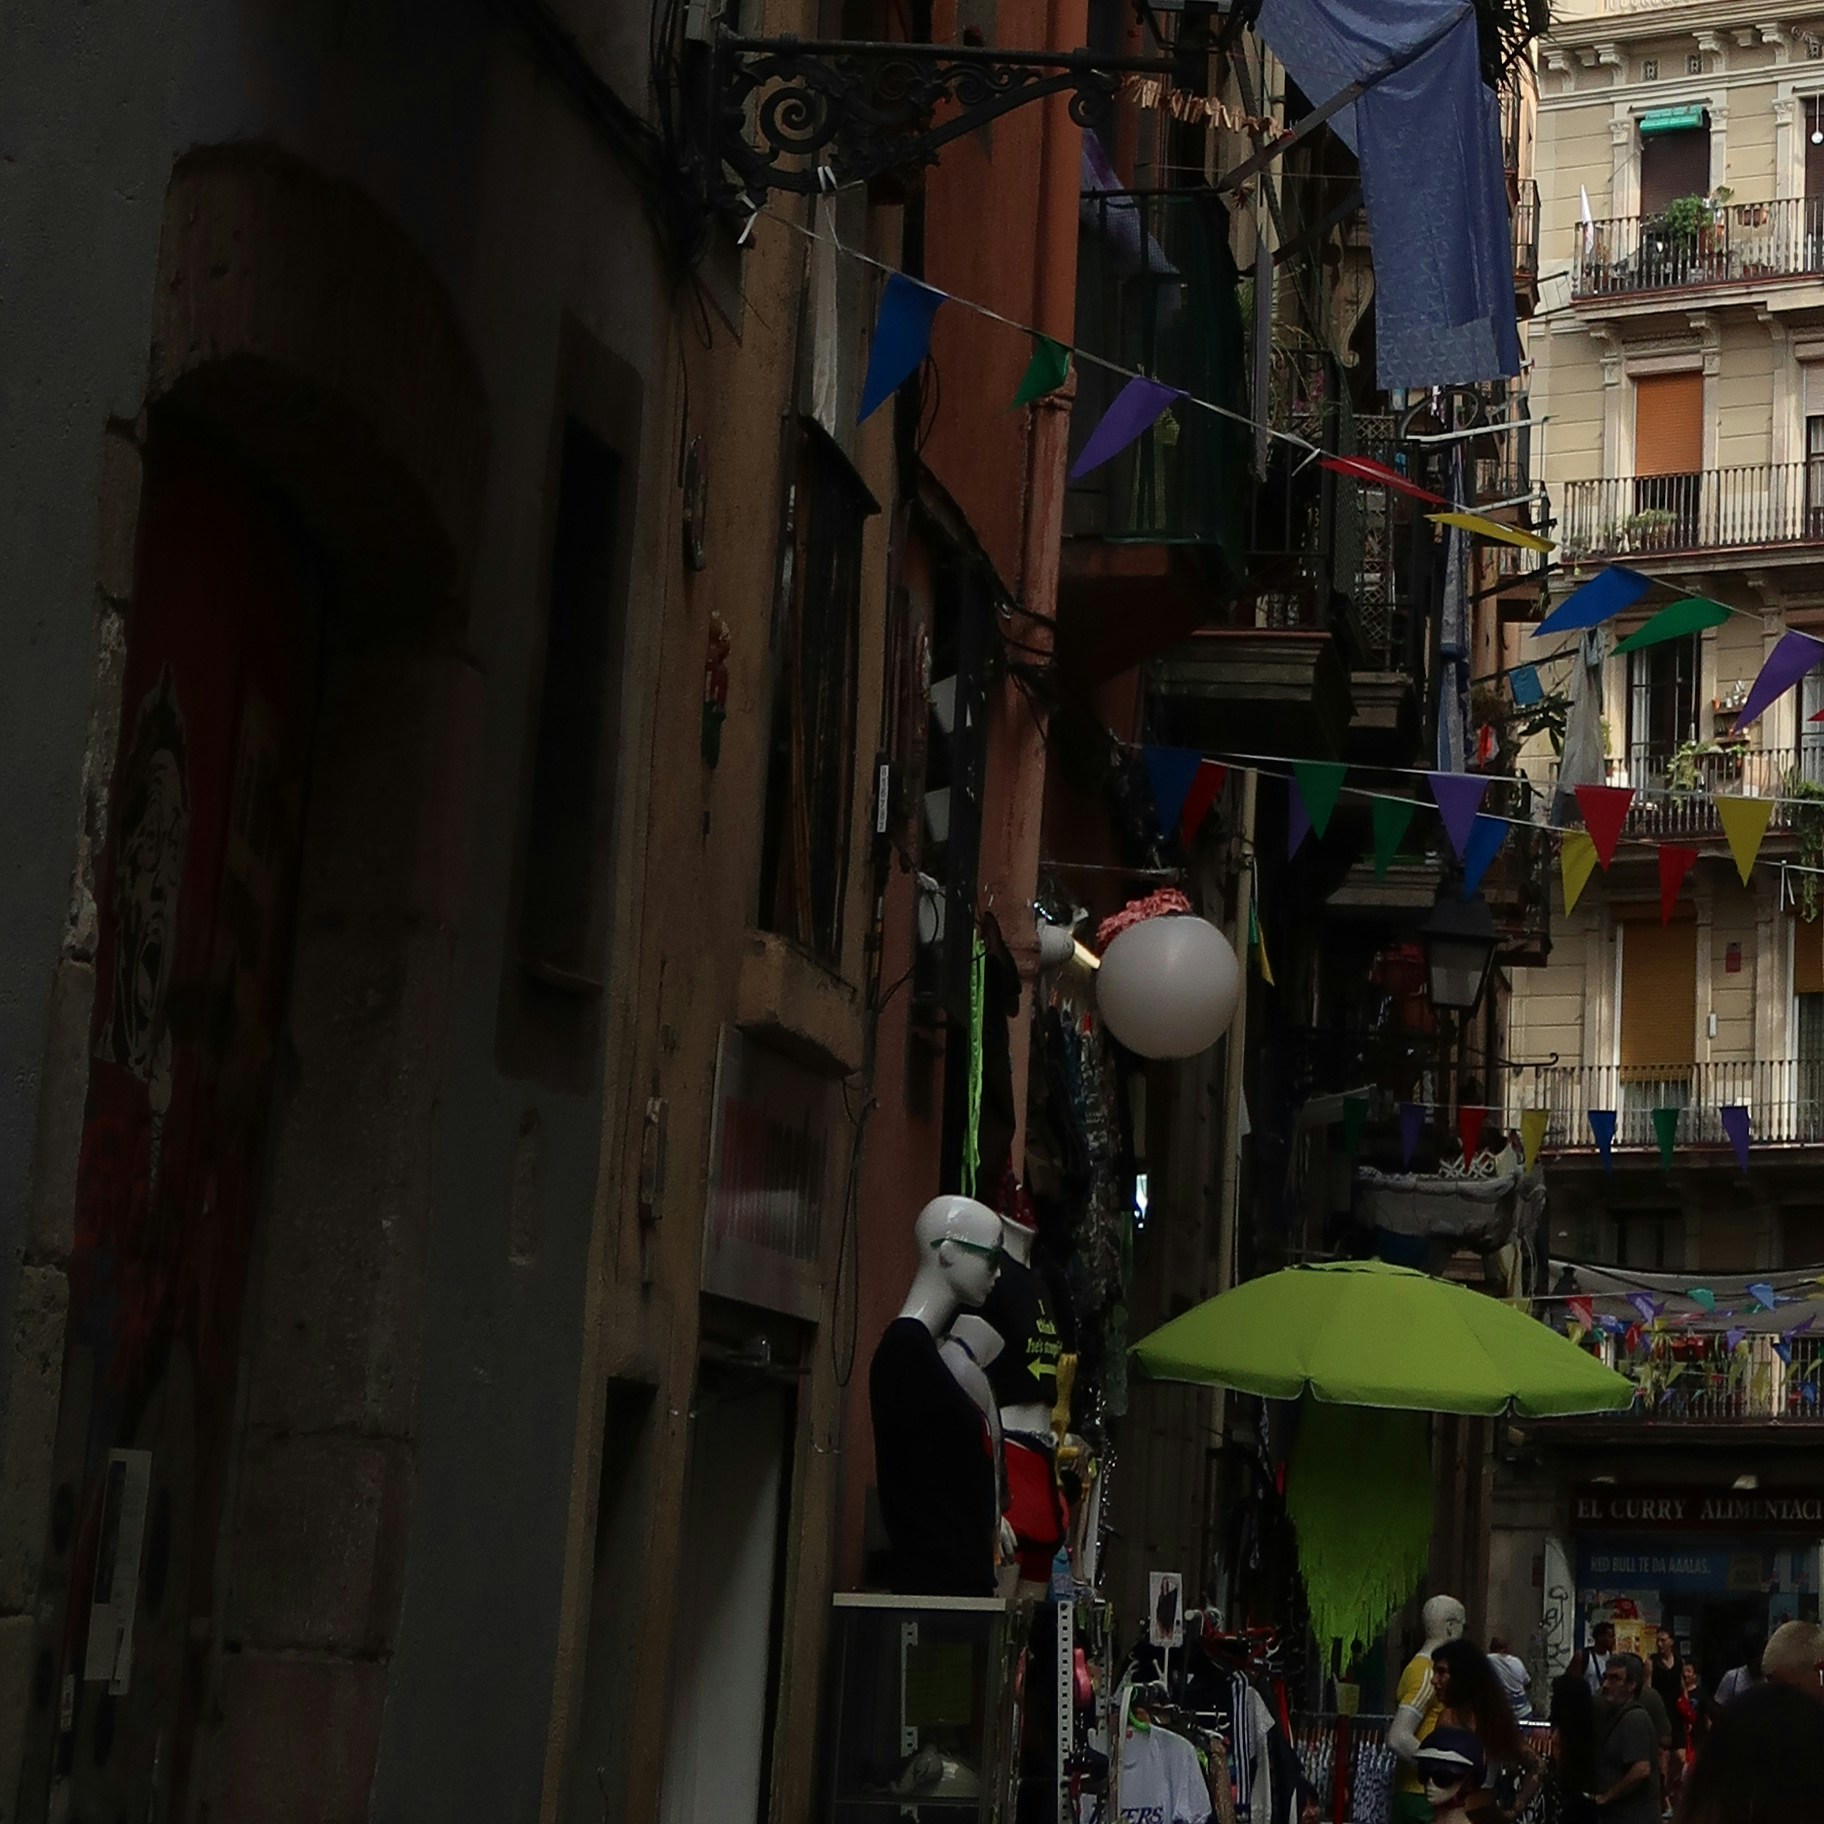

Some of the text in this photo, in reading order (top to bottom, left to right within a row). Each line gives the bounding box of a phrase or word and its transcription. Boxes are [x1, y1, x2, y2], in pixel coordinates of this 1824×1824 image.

[1577, 1500, 1604, 1520] EL
[1610, 1499, 1688, 1520] CURRY
[1590, 1555, 1610, 1573] RED
[1612, 1556, 1638, 1573] BULL
[1639, 1556, 1650, 1573] TE
